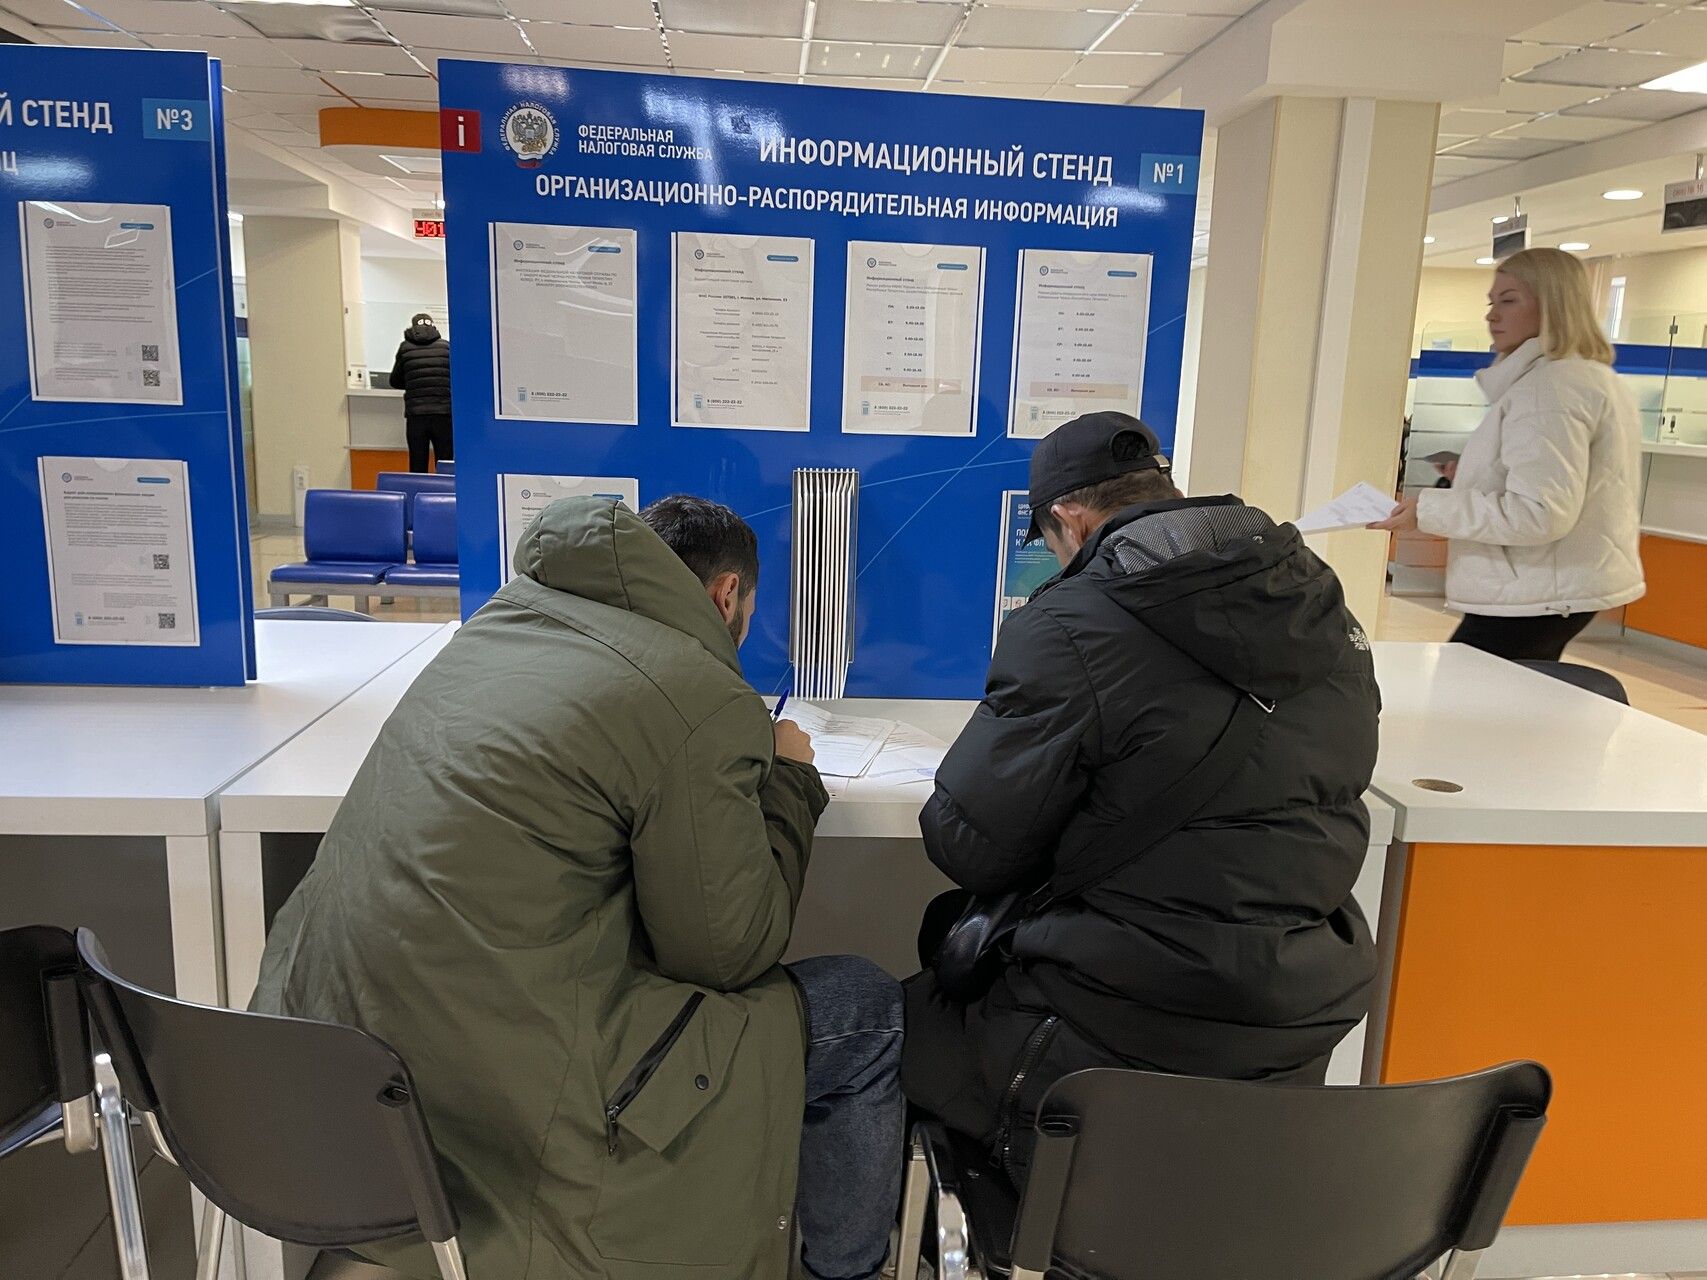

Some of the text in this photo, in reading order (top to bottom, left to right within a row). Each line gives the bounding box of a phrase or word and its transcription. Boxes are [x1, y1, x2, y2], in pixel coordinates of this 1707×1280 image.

[22, 99, 113, 134] СТЕНД
[157, 107, 193, 131] №3
[578, 124, 674, 143] ФЕДЕРАЛЬНАЯ
[578, 139, 713, 161] НАЛОГОВАЯ СЛУЖБА
[759, 136, 1113, 187] ИНФОРМАЦИОННЫЙ СТЕНД
[1153, 162, 1185, 185] №1
[535, 173, 1119, 230] ОРГАНИЗАЦИОННО-РАСПОРЯДИТЕЛЬНАЯ ИНФОРМАЦИЯ
